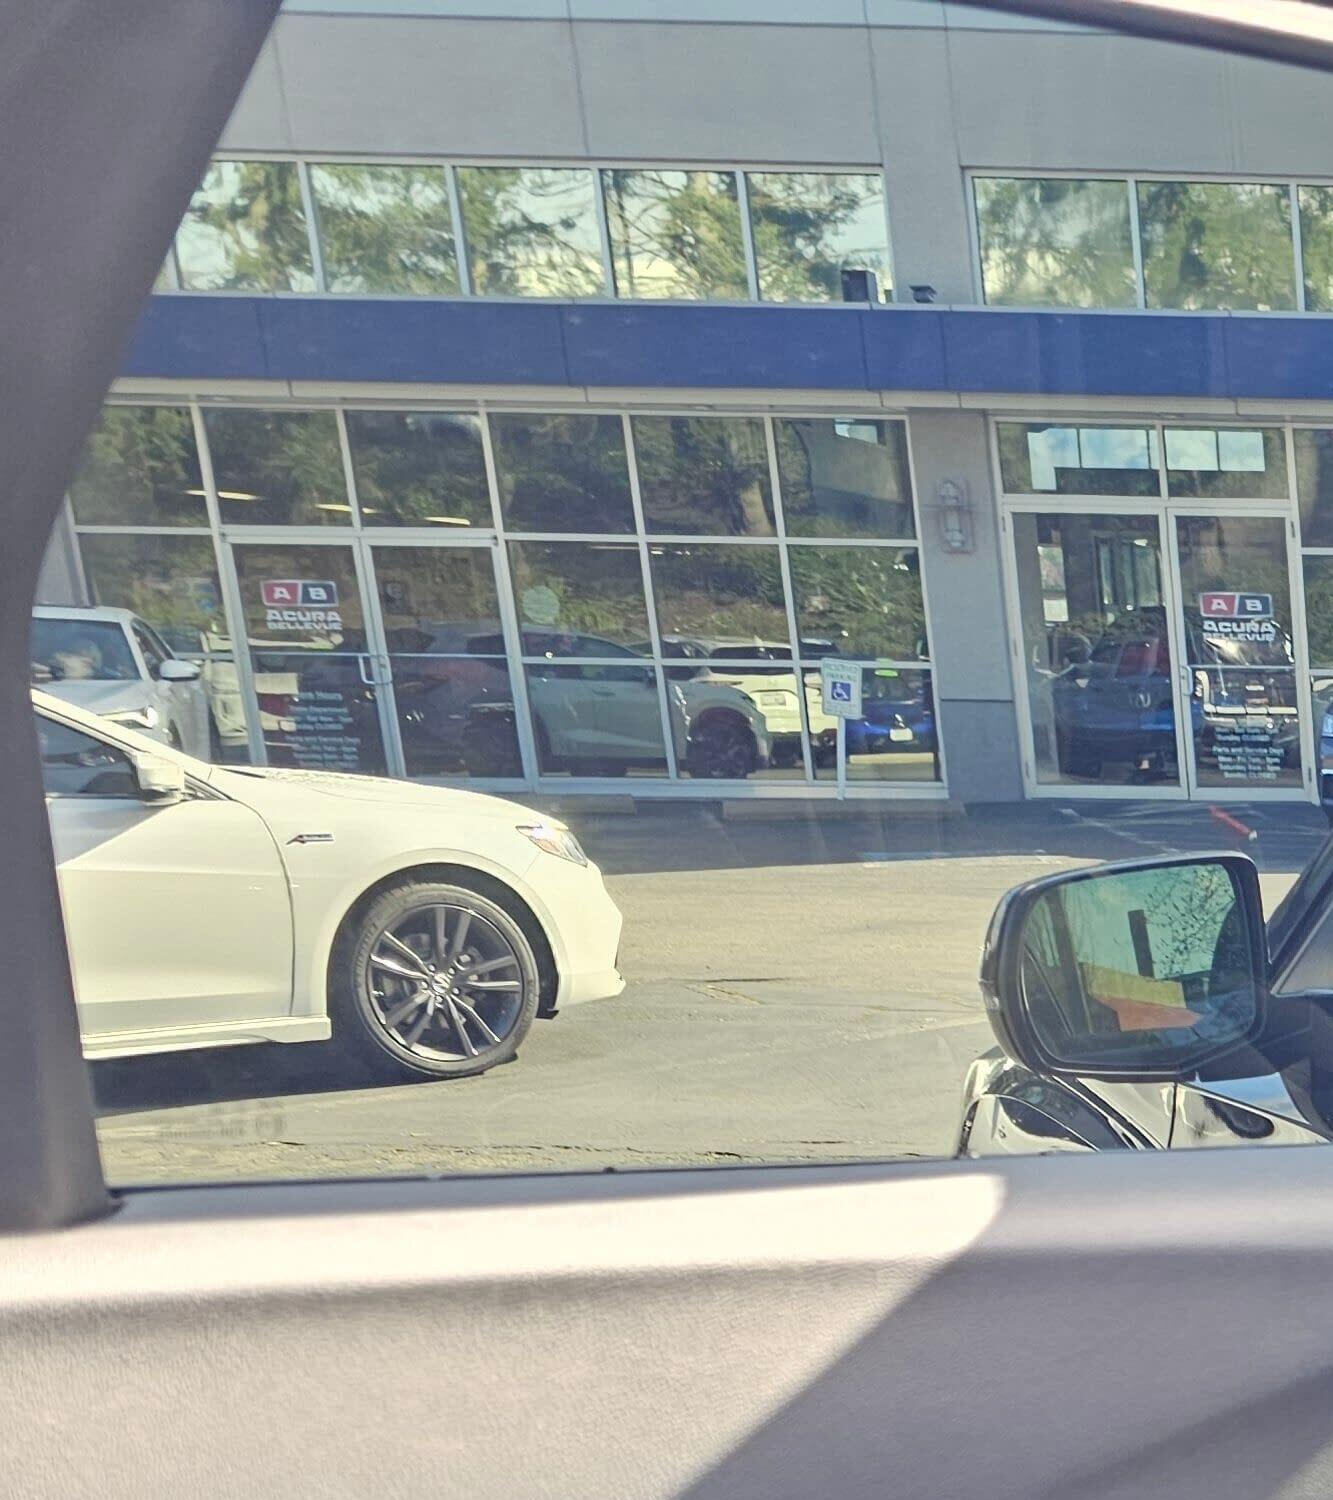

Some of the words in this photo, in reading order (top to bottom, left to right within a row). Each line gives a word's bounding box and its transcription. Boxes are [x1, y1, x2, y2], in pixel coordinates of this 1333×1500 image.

[273, 587, 292, 600] A
[308, 587, 328, 600] B
[1211, 598, 1228, 611] A
[1244, 599, 1263, 612] B
[266, 609, 342, 622] ACURA
[266, 621, 343, 630] BELLEVUE
[1203, 619, 1275, 633] ACURA
